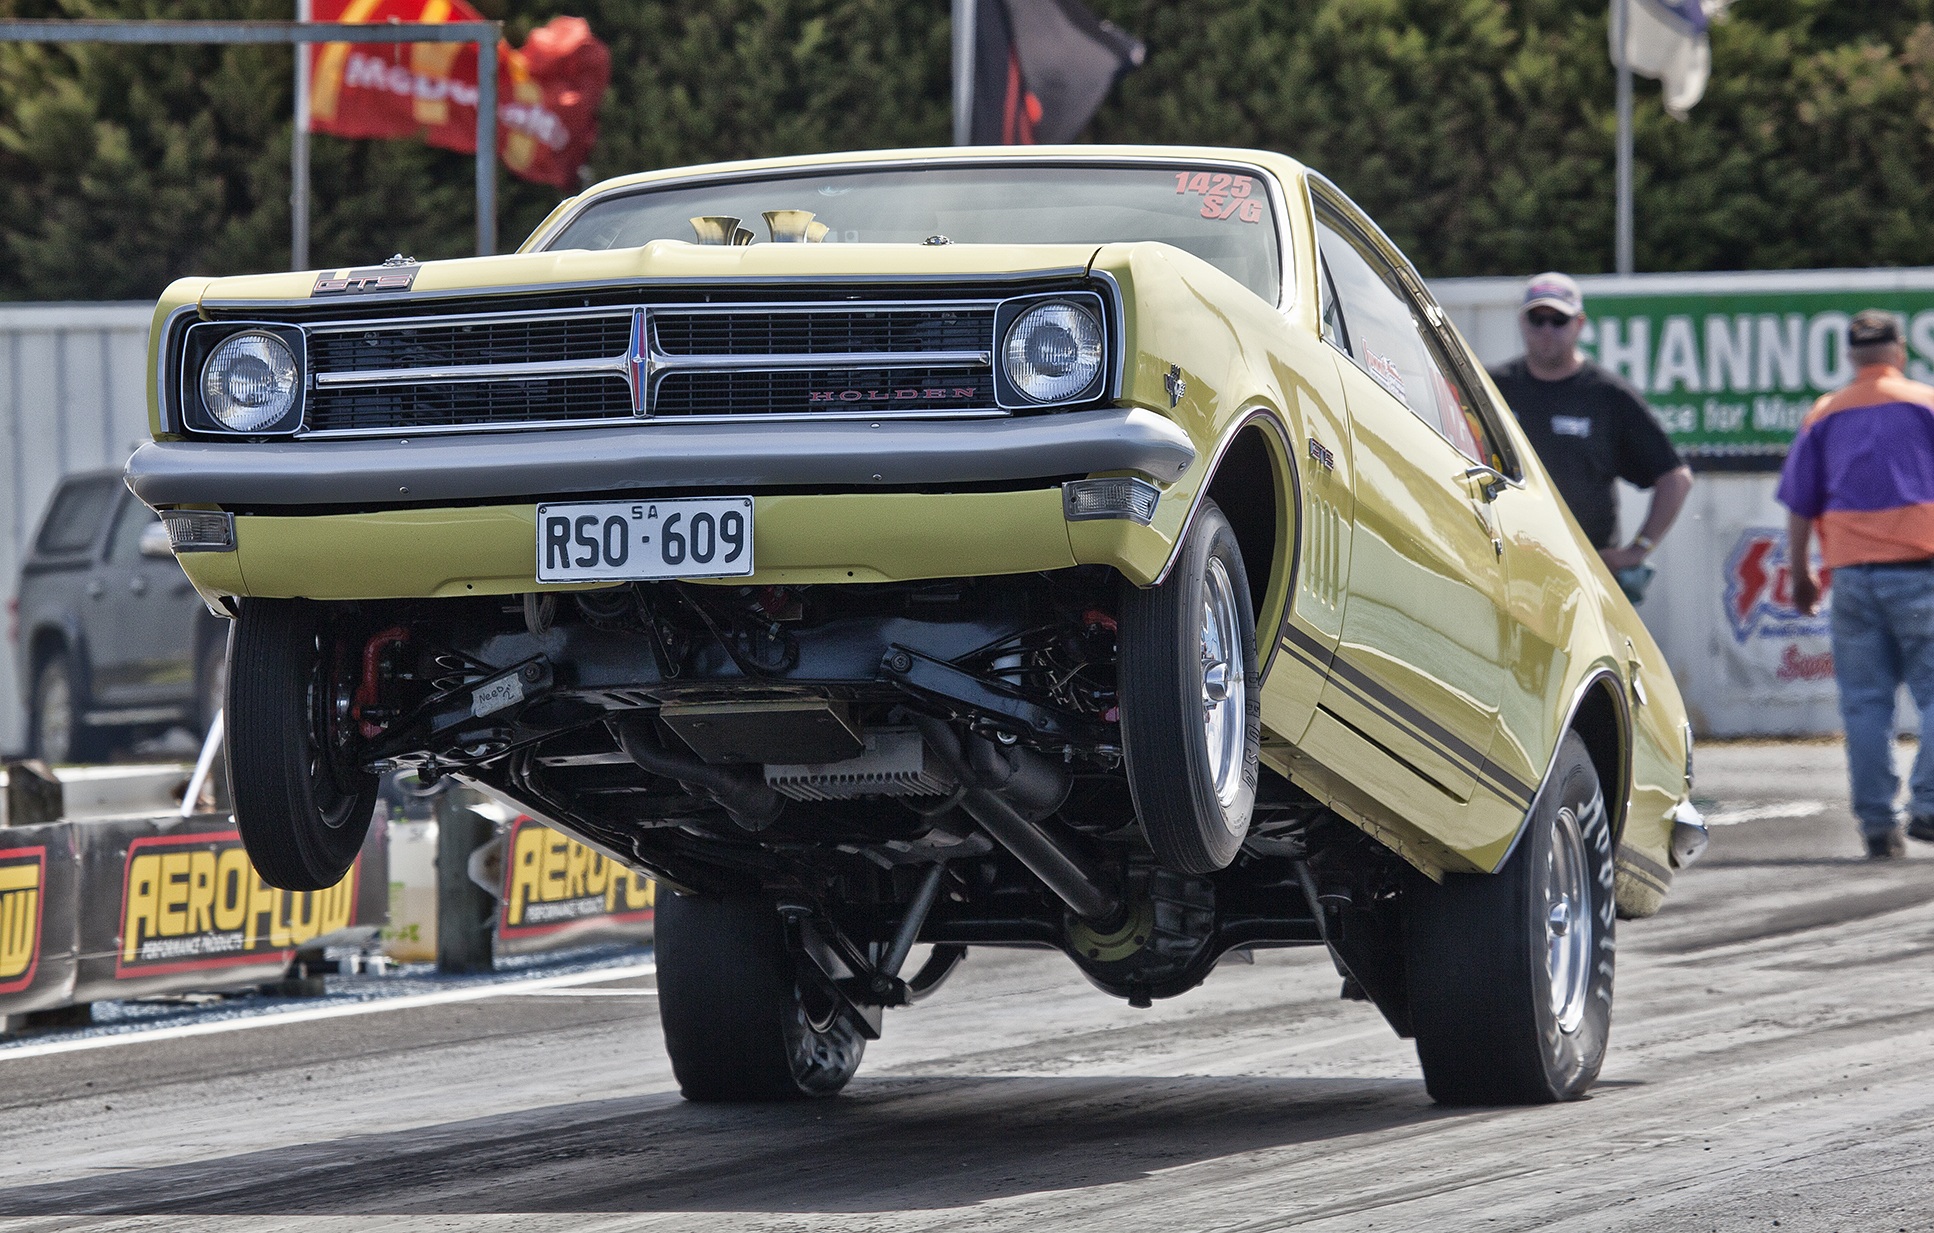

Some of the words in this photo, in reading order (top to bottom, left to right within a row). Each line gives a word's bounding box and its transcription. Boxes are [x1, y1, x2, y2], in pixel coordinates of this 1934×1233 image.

[1175, 171, 1252, 198] 1425
[1200, 195, 1262, 224] S/G
[313, 274, 413, 293] GTS
[1578, 312, 1934, 393] HANNOS
[809, 387, 977, 401] HOLDEN
[1309, 438, 1334, 470] GTS
[632, 505, 658, 520] SA
